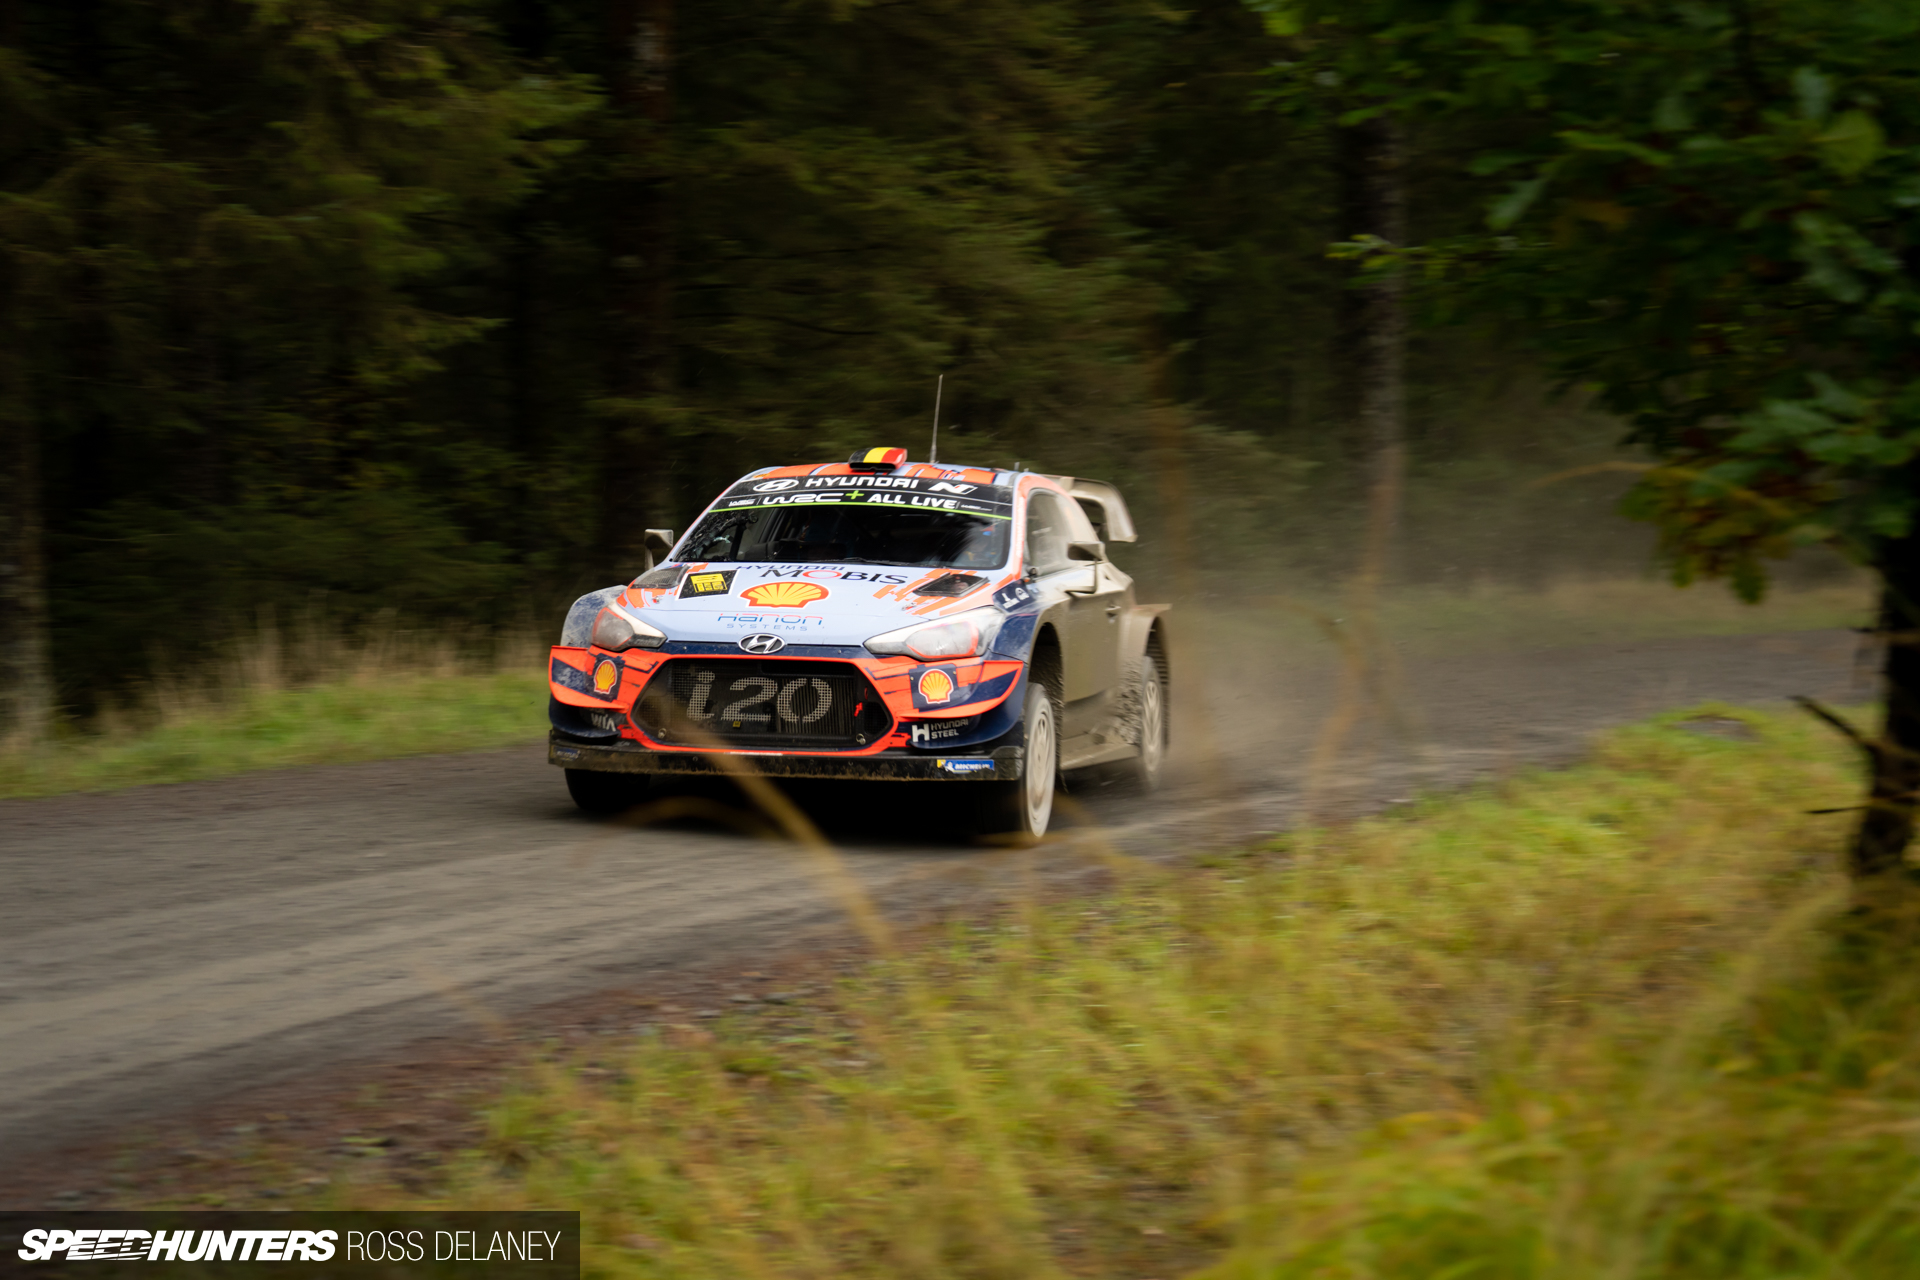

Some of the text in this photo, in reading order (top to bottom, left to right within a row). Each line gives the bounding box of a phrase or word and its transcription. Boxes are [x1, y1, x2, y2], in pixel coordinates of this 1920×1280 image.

[805, 476, 919, 489] HYUNDAI
[867, 493, 906, 504] ALL
[911, 497, 957, 509] LIVE
[760, 569, 908, 584] MOBIS
[727, 623, 808, 632] SYSTEMS
[931, 719, 969, 731] HYUNDAI
[931, 729, 959, 739] STEEL
